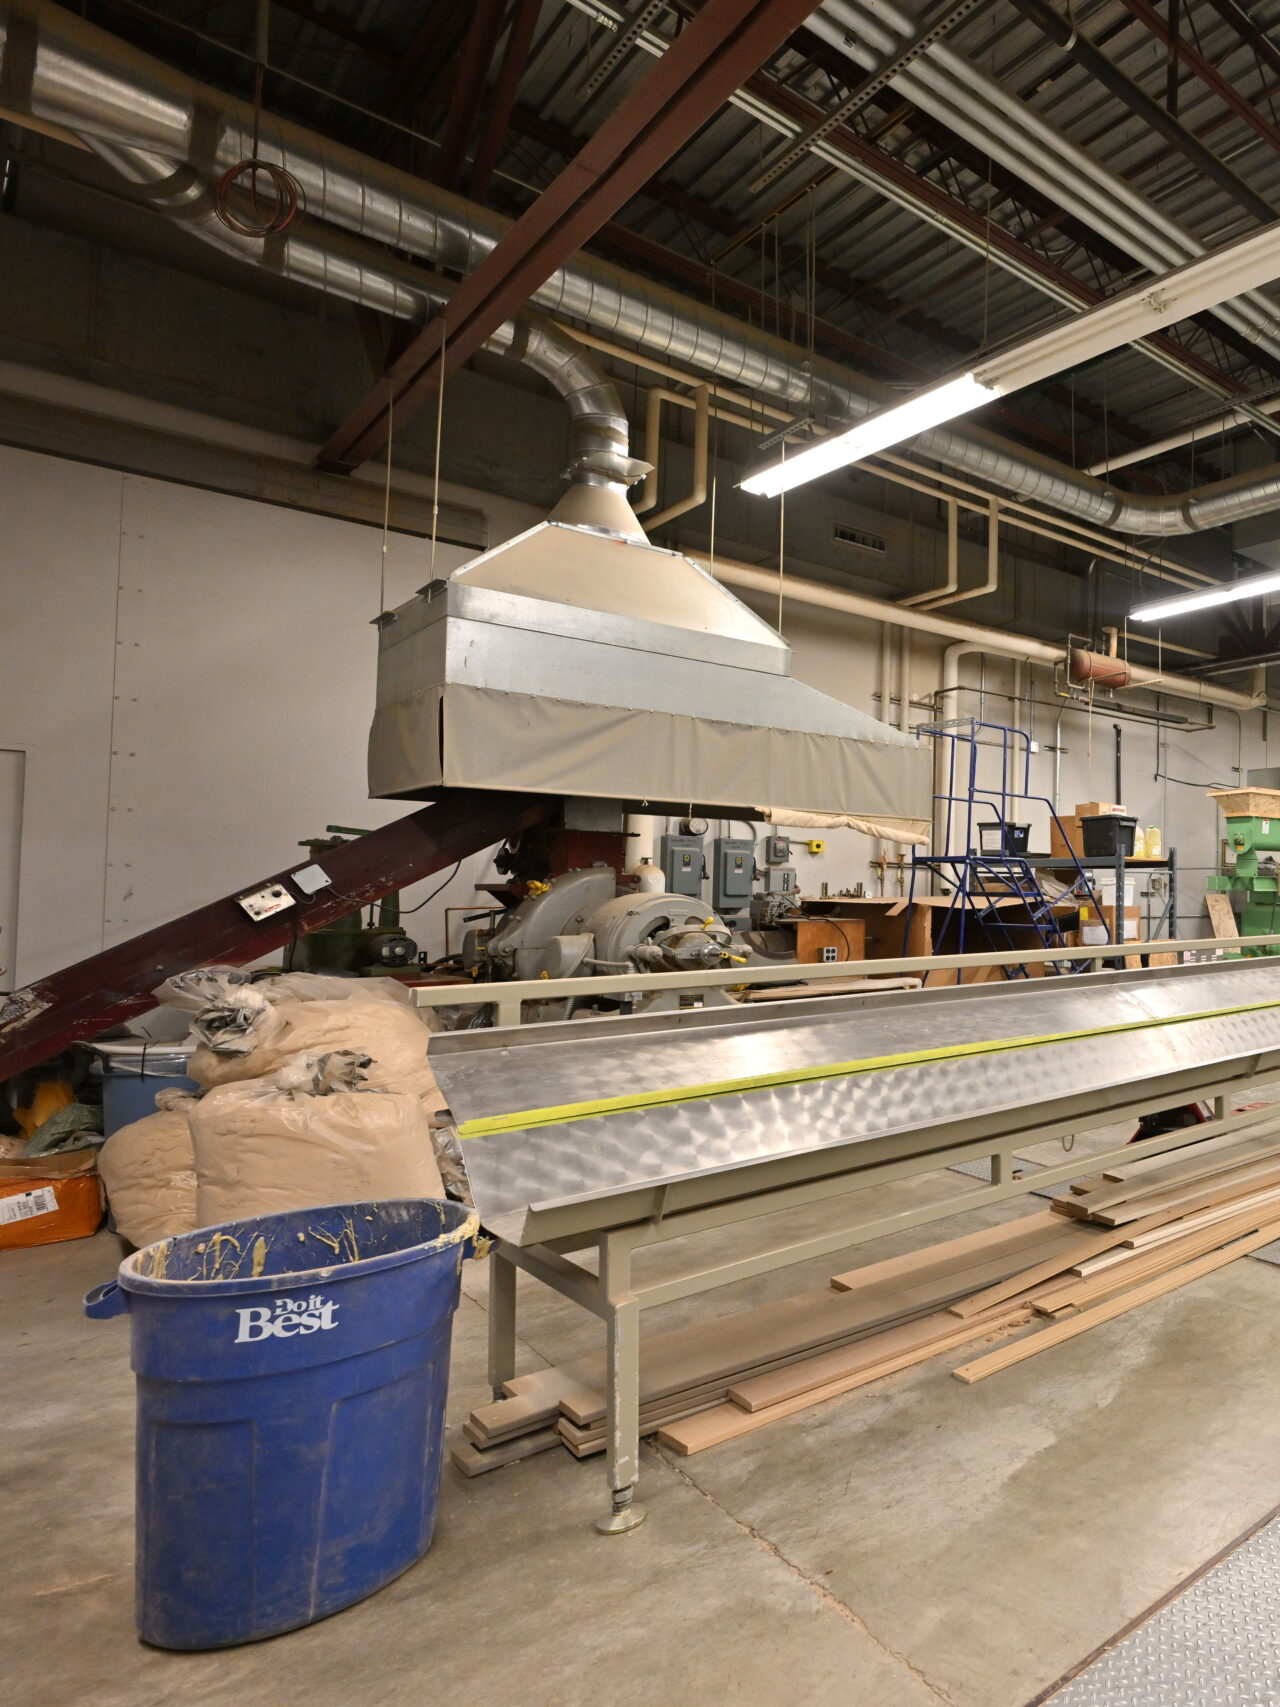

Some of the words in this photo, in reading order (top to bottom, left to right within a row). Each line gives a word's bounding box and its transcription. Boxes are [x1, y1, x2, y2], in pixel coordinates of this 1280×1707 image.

[273, 1298, 307, 1316] Do
[308, 1294, 325, 1311] it
[234, 1300, 340, 1344] Best
